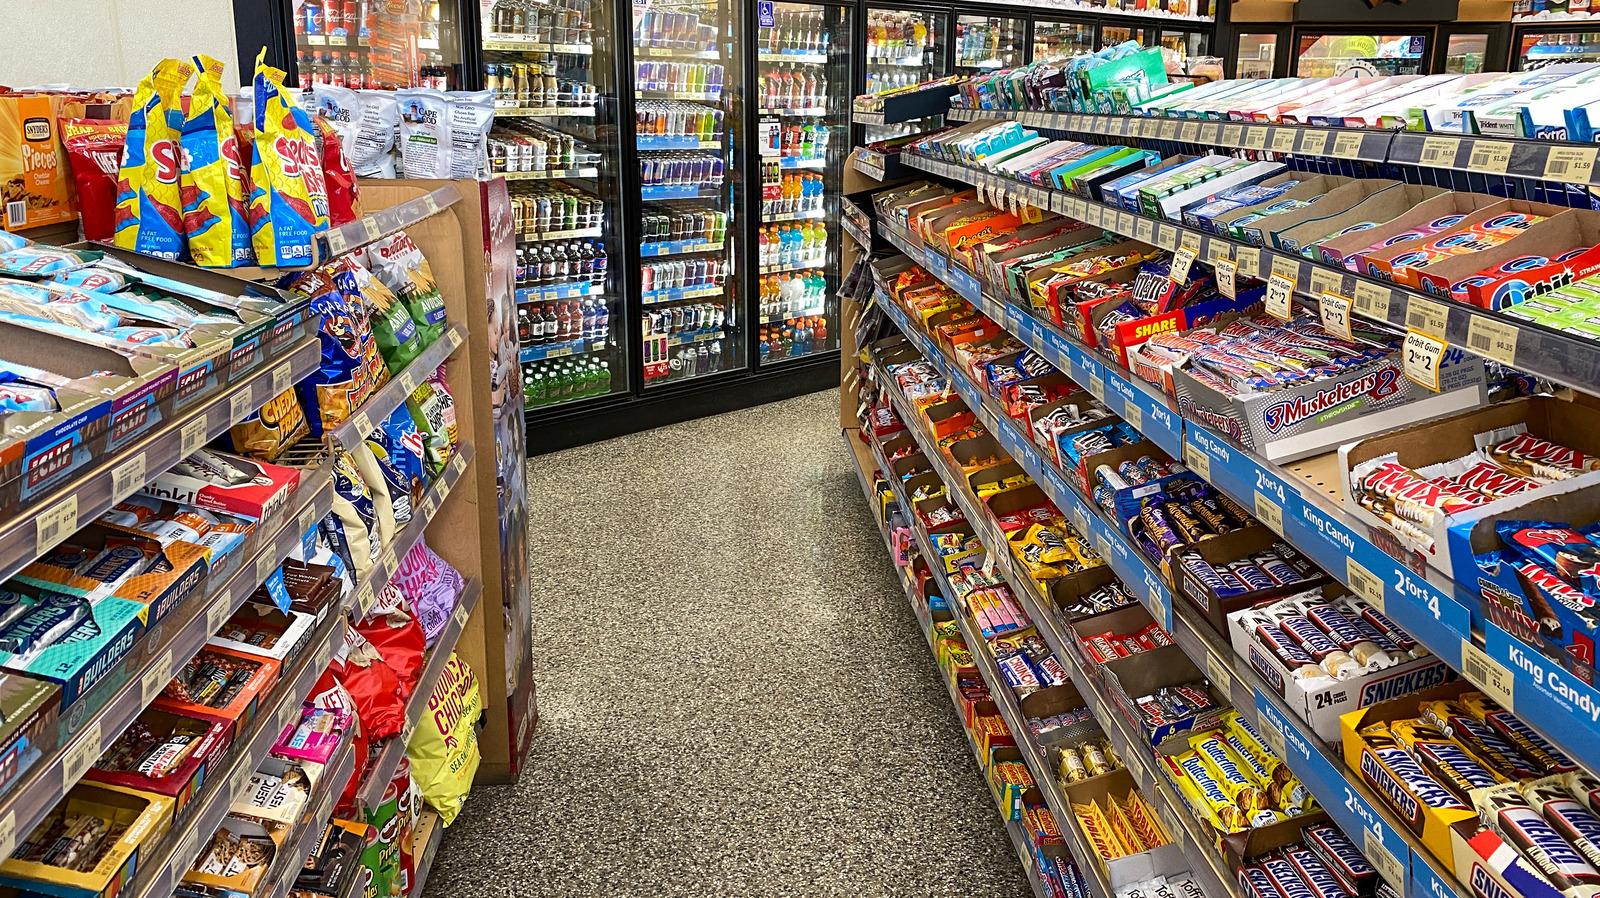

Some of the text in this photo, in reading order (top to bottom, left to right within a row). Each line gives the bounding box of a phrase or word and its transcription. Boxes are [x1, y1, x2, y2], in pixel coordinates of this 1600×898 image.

[332, 106, 350, 116] CAPE
[334, 114, 351, 123] COD
[418, 107, 438, 119] CAPE
[421, 115, 437, 125] COD
[64, 123, 95, 137] GRAB
[1480, 120, 1498, 129] Trident
[1537, 127, 1567, 140] Extra
[21, 143, 57, 173] Pieces
[1573, 162, 1591, 170] $1.59
[1420, 275, 1452, 299] Orbit
[1490, 269, 1577, 313] Orbit
[1321, 296, 1347, 312] Orbit Gum
[1134, 317, 1177, 338] SHARE
[1429, 319, 1445, 330] $1.59
[1051, 335, 1070, 355] King Candy
[1407, 335, 1440, 355] Orbit Gum
[1496, 341, 1514, 352] $0.35
[1439, 348, 1465, 369] 24
[1460, 366, 1475, 374] PKGS
[1110, 375, 1135, 402] King Candy
[1266, 406, 1284, 430] 3
[1283, 371, 1377, 425] Musketeers
[11, 424, 30, 435] 12
[55, 415, 88, 437] CHOCOLATE CHIP
[1194, 430, 1209, 450] King
[1209, 437, 1230, 463] Candy
[1498, 432, 1594, 470] TWIX
[1363, 461, 1448, 508] TWIX
[63, 510, 77, 524] $1.99
[1302, 505, 1356, 554] King Candy
[1104, 528, 1128, 560] King Candy
[160, 566, 202, 615] BUILDERS
[1368, 586, 1382, 600] $2.19
[1286, 617, 1340, 652] SNICKERS
[1313, 607, 1366, 641] SNICKERS
[1301, 640, 1317, 655] WHITE
[1328, 629, 1345, 645] WHITE
[54, 662, 73, 674] 12
[82, 627, 136, 687] BUILDERS
[1250, 647, 1281, 686] SNICKERS
[1008, 656, 1038, 686] CRUNCH
[1041, 657, 1066, 682] CRUNCH
[1362, 662, 1448, 708] SNICKERS
[1492, 678, 1512, 697] $2.19
[1508, 644, 1600, 723] King Candy
[1314, 690, 1334, 710] 24
[1333, 695, 1348, 705] PACKS
[1265, 704, 1311, 761] King Candy
[449, 757, 462, 774] SEA
[1200, 739, 1250, 786] Butterfinger
[1181, 756, 1231, 804] Butterfinger
[1362, 754, 1418, 821] SNICKERS
[1375, 748, 1469, 809] SNICKERS
[1083, 814, 1113, 862] TOBLERO
[378, 839, 399, 866] Pring
[1526, 845, 1559, 875] ALMOND
[1573, 837, 1600, 867] ALMOND
